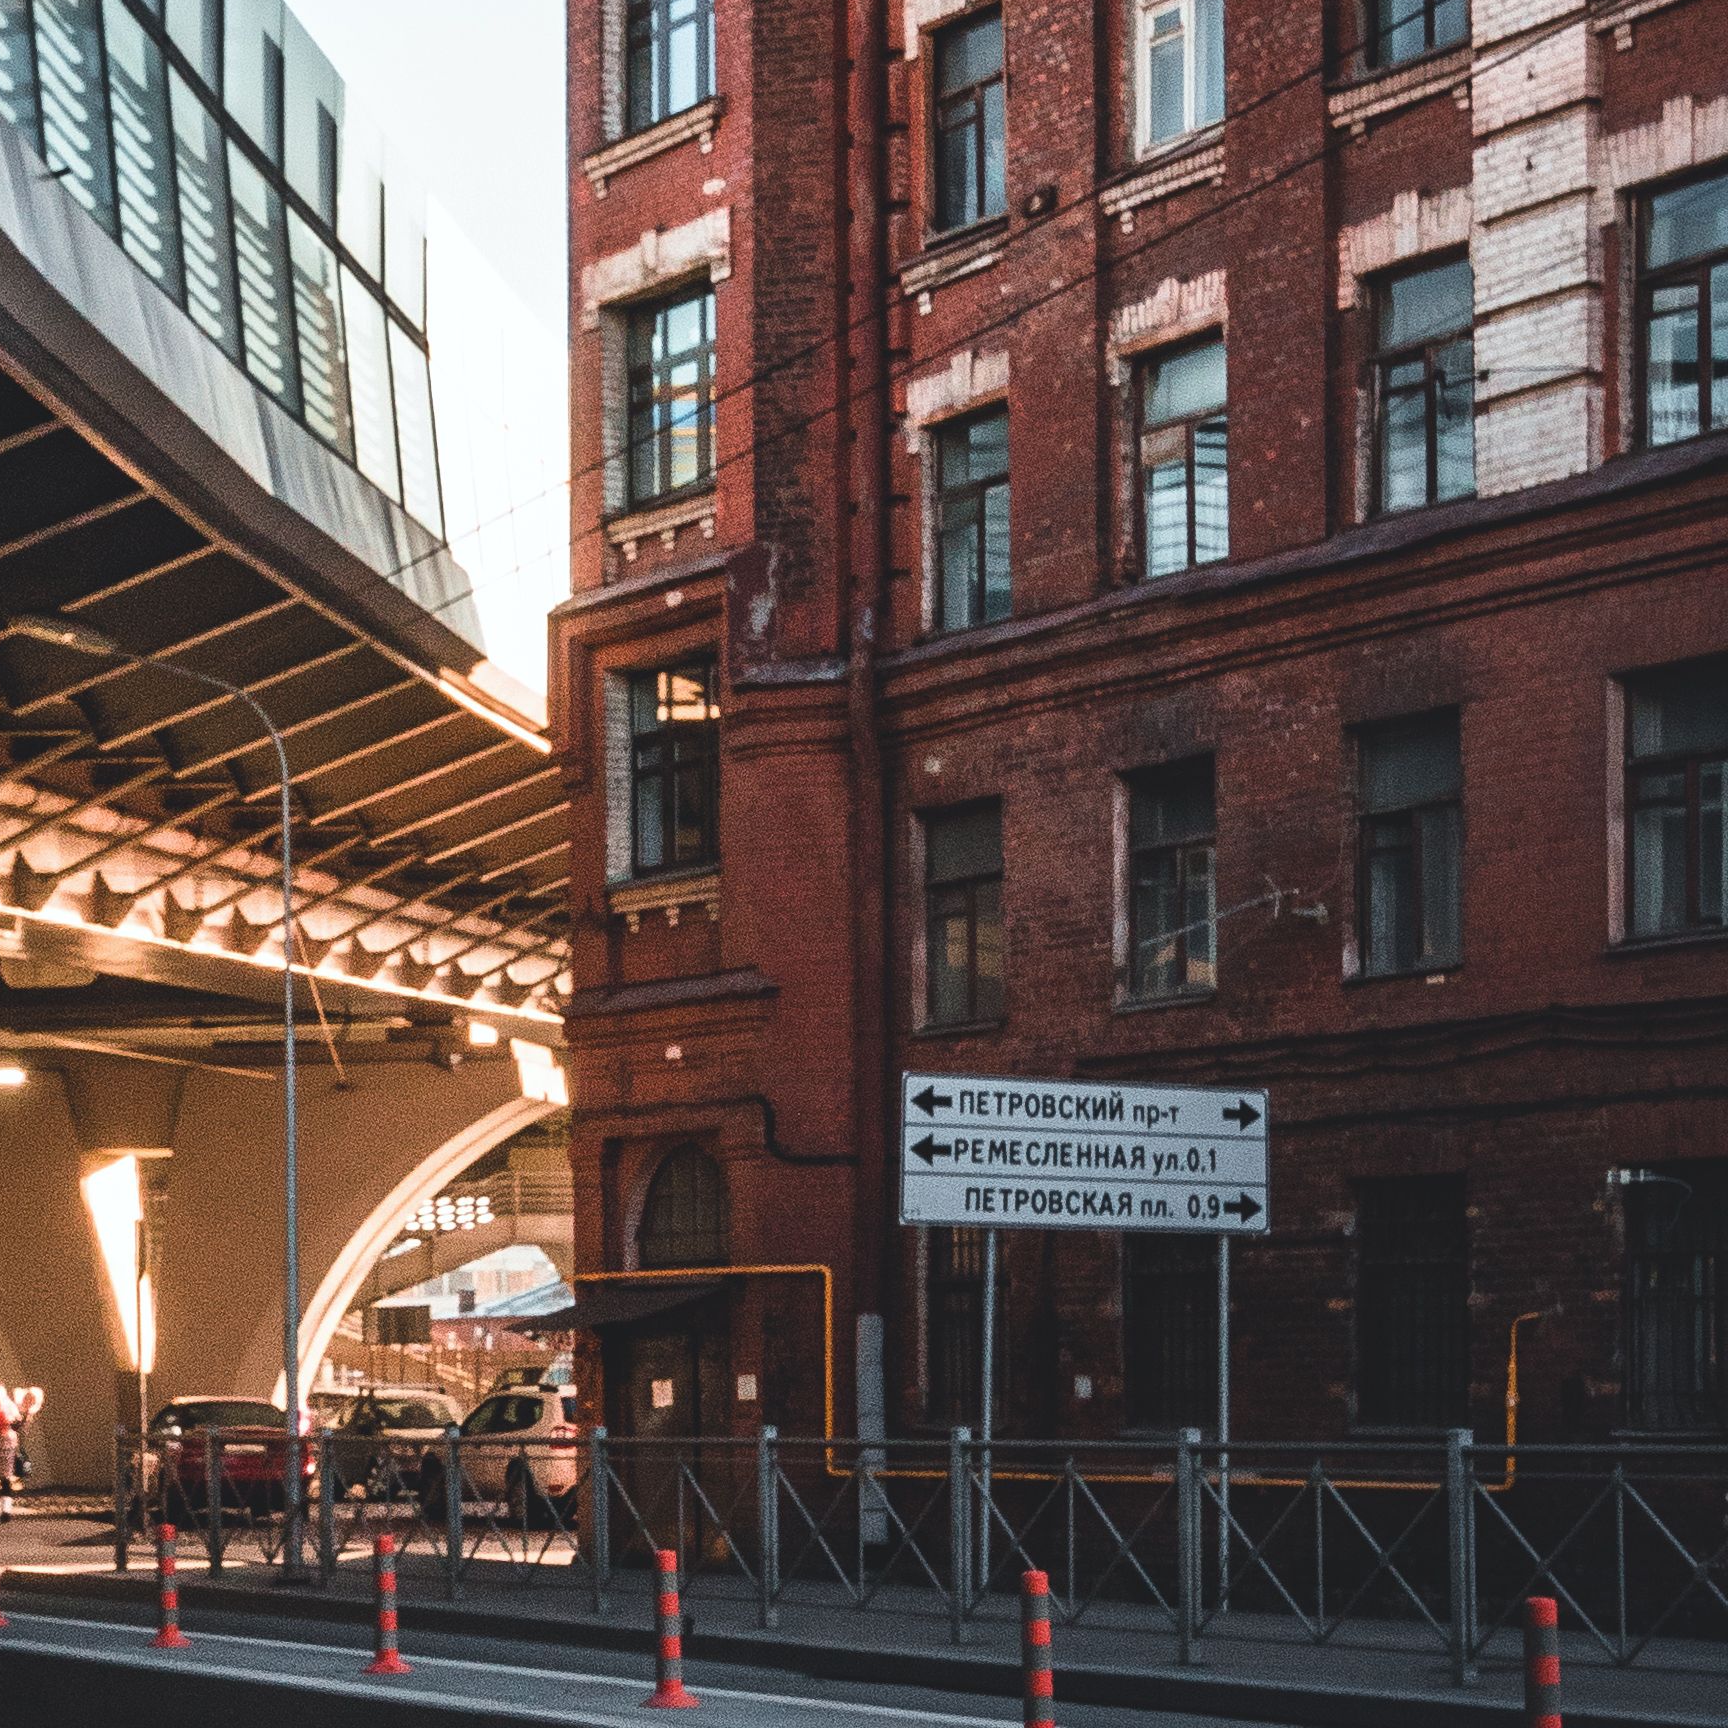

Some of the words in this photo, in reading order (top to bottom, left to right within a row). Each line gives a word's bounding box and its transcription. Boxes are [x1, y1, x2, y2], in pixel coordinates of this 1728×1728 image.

[959, 1090, 1125, 1121] ПЕТРОВСКИЙ
[1133, 1104, 1179, 1128] пр-т
[954, 1139, 1145, 1170] РЕМЕСЛЕННАЯ
[964, 1187, 1132, 1217] ПЕТРОВСКАЯ
[1140, 1199, 1174, 1218] пл.
[1187, 1194, 1221, 1219] 0,9
